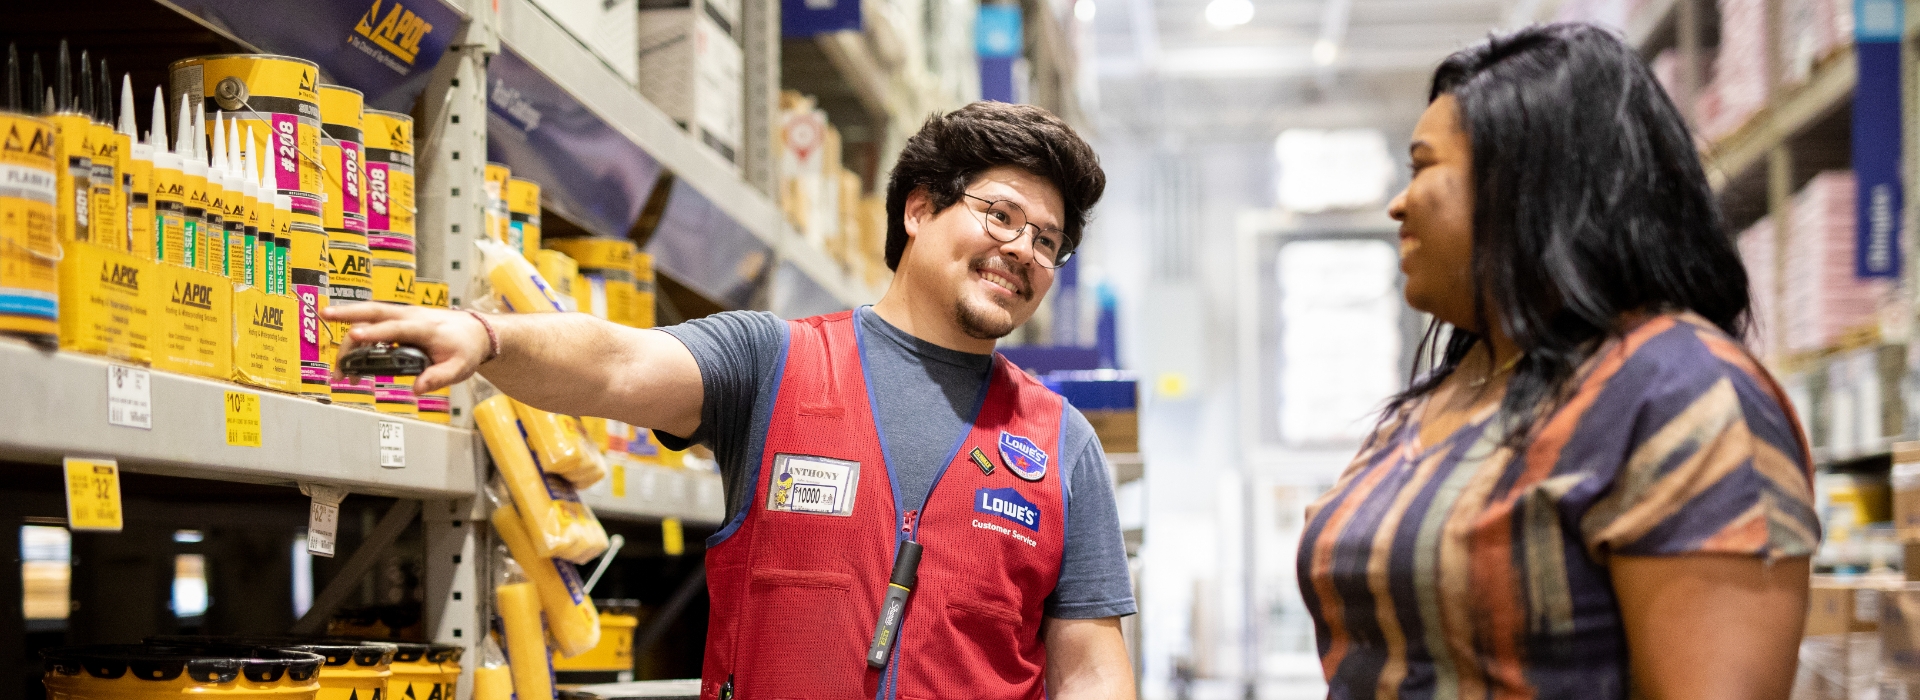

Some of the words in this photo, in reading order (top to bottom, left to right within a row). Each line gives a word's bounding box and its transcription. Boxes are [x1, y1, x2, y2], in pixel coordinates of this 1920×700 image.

[369, 2, 433, 58] APOC
[279, 121, 296, 173] #208
[345, 148, 358, 197] #208
[371, 168, 387, 215] #208
[110, 262, 139, 287] APOC
[341, 254, 371, 276] APO
[181, 281, 213, 307] APOC
[261, 305, 284, 328] APOC
[303, 292, 317, 344] #208
[1005, 434, 1043, 462] LOWE'S
[789, 467, 839, 481] ANTHONY
[982, 492, 1035, 526] LOWE'S
[972, 519, 1011, 535] Customer
[1012, 530, 1037, 547] Service
